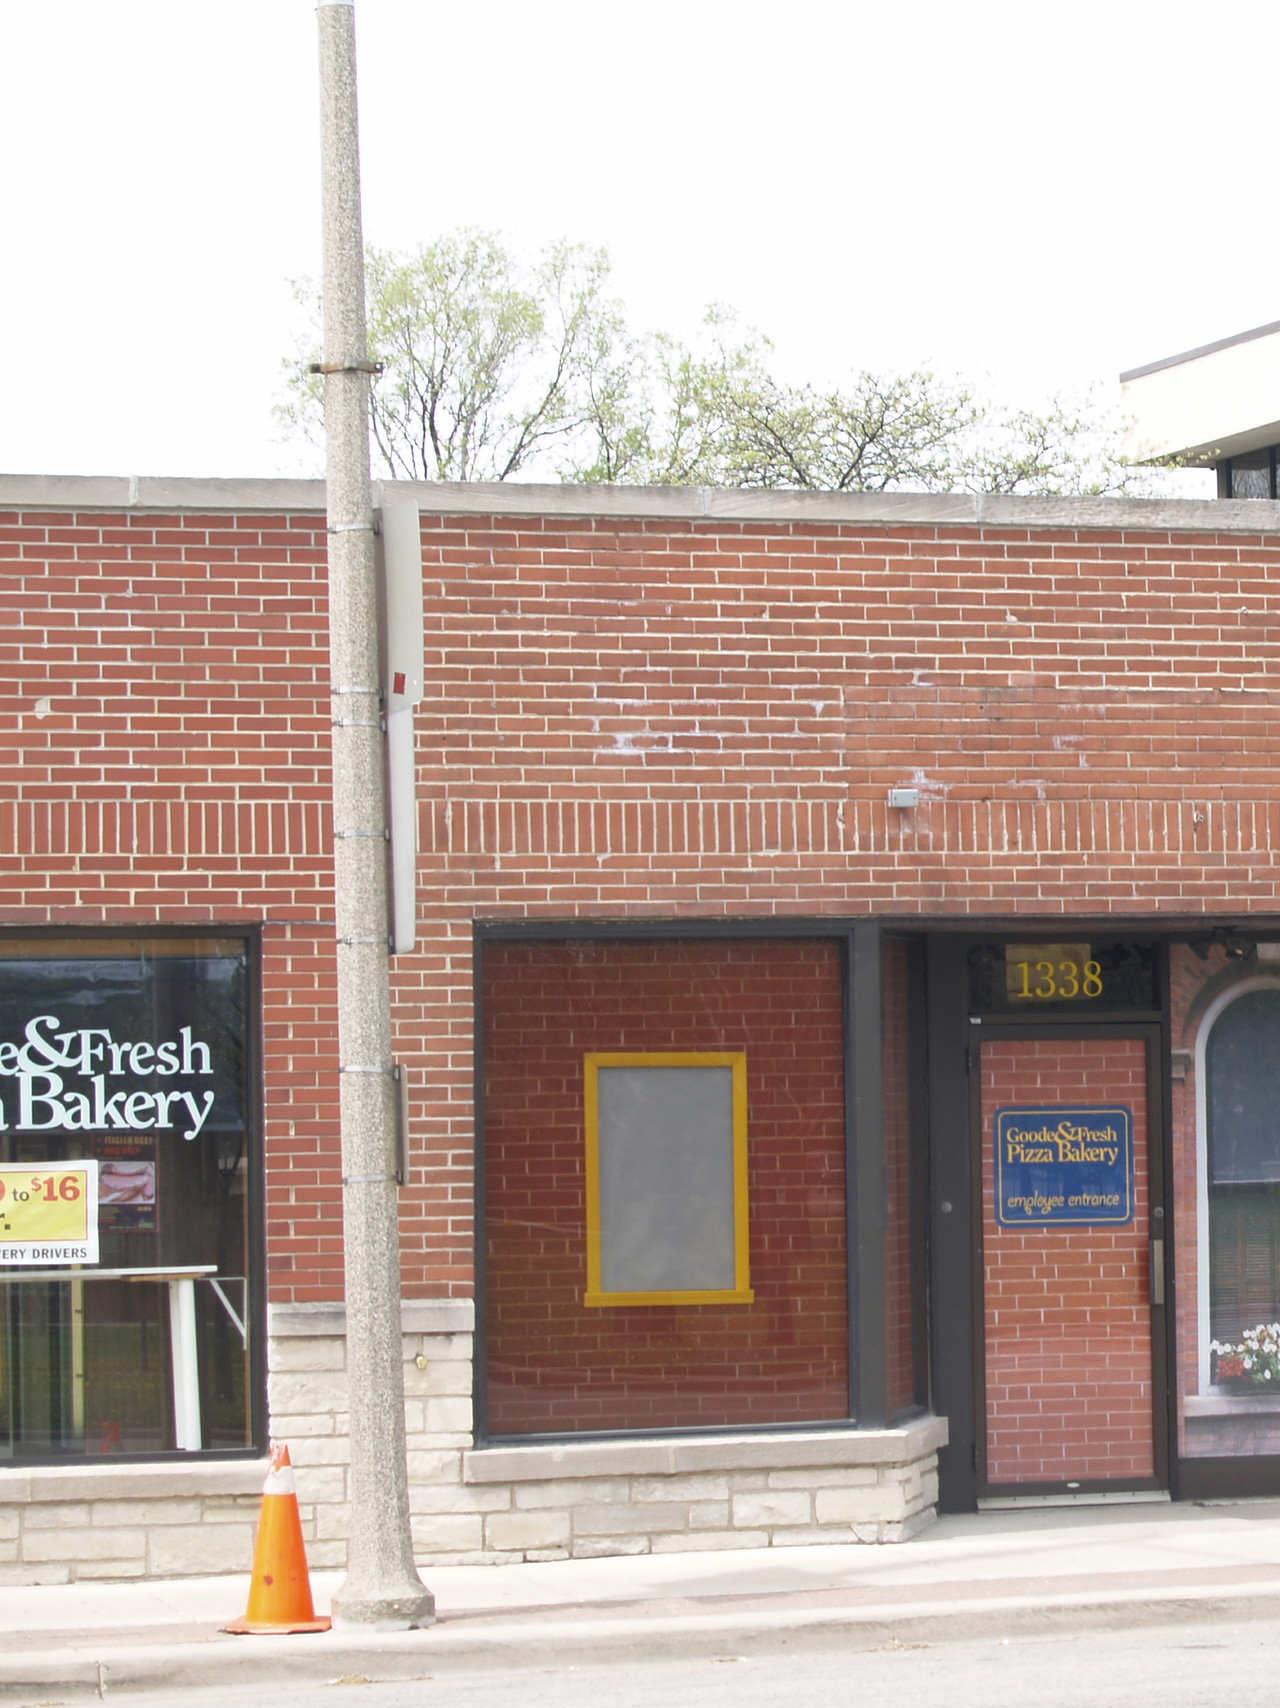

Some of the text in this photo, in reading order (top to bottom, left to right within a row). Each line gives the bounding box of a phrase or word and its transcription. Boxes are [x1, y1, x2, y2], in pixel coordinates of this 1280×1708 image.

[1016, 960, 1103, 998] 1338
[15, 1071, 215, 1141] Bakery
[1006, 1142, 1119, 1166] Pizza Bakery
[12, 1188, 30, 1202] to
[31, 1175, 81, 1202] $16
[1007, 1190, 1120, 1215] employee entrance
[0, 1247, 87, 1260] ERY DRIVERS
